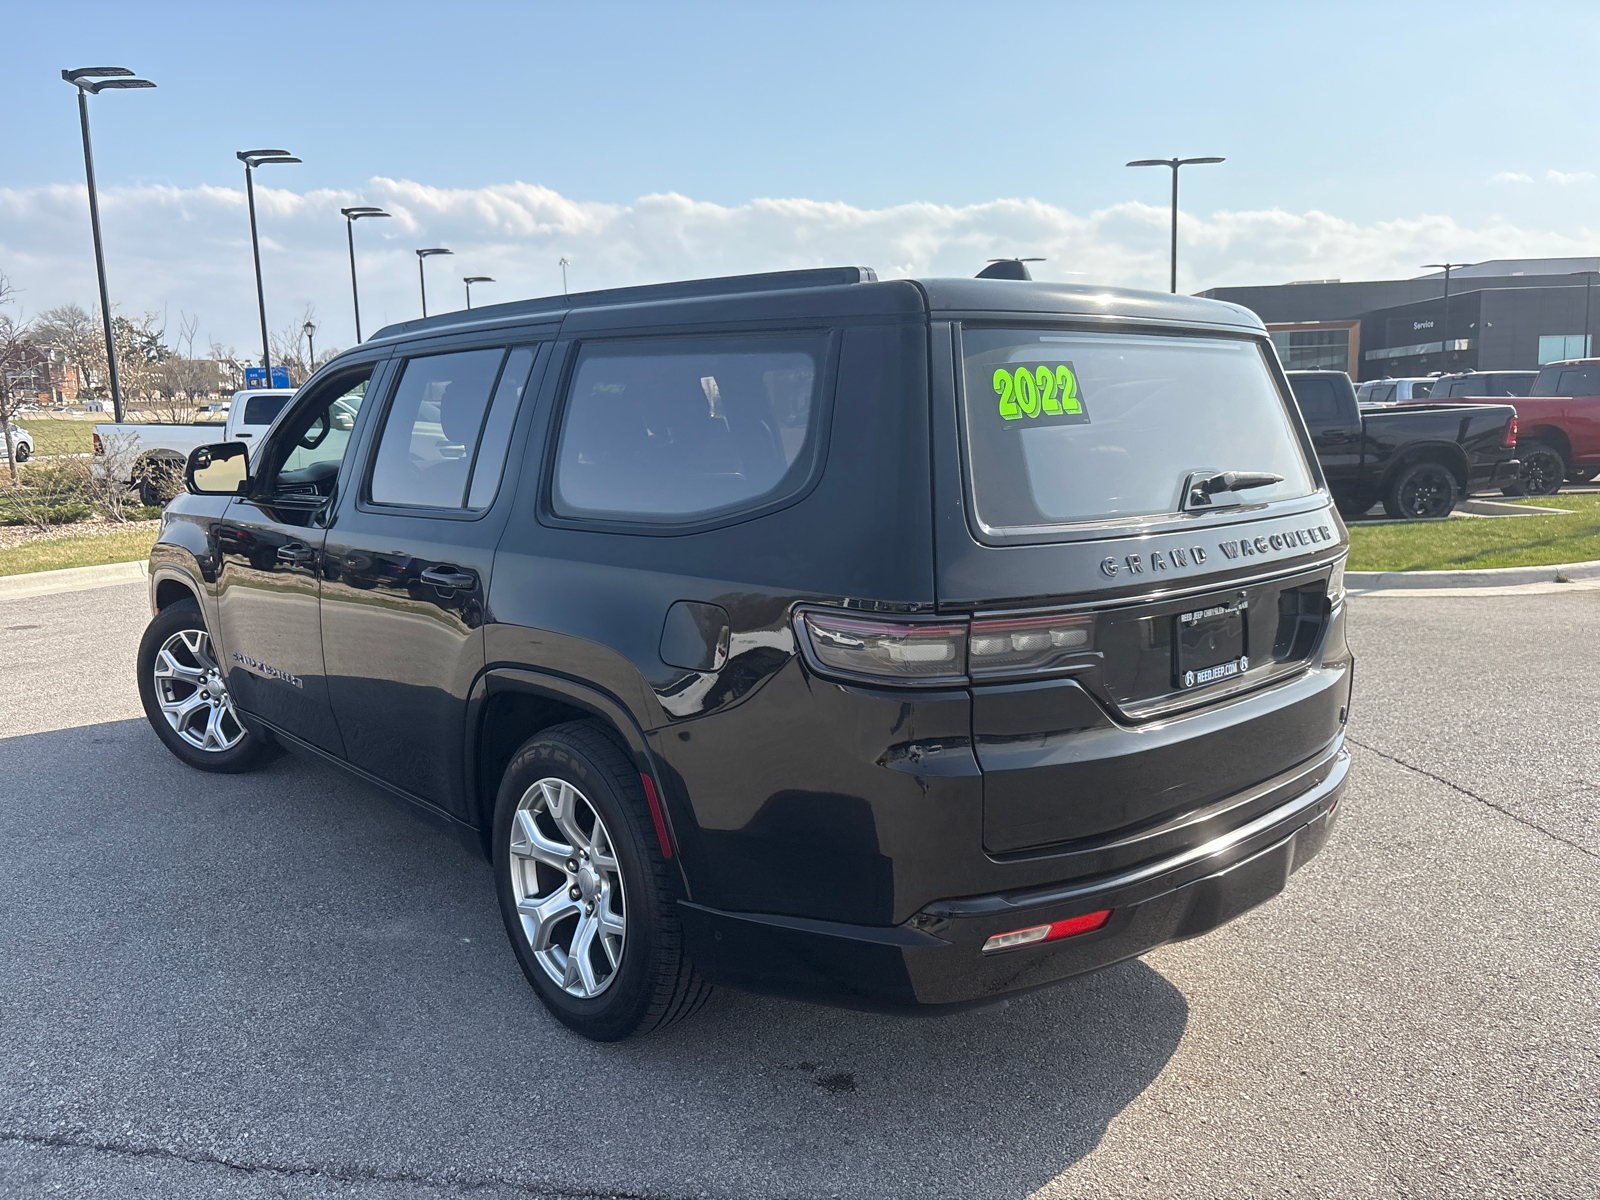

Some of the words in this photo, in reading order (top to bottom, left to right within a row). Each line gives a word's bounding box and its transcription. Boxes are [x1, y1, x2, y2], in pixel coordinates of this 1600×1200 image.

[1413, 320, 1434, 330] Service
[993, 364, 1083, 421] 2022
[1100, 545, 1208, 577] GRAND
[1218, 524, 1332, 559] WAGONEER
[1181, 612, 1192, 623] REED
[1193, 610, 1203, 620] JEEP
[1203, 606, 1225, 618] CHRYSLER
[1197, 662, 1238, 684] REEDJEEP.COM
